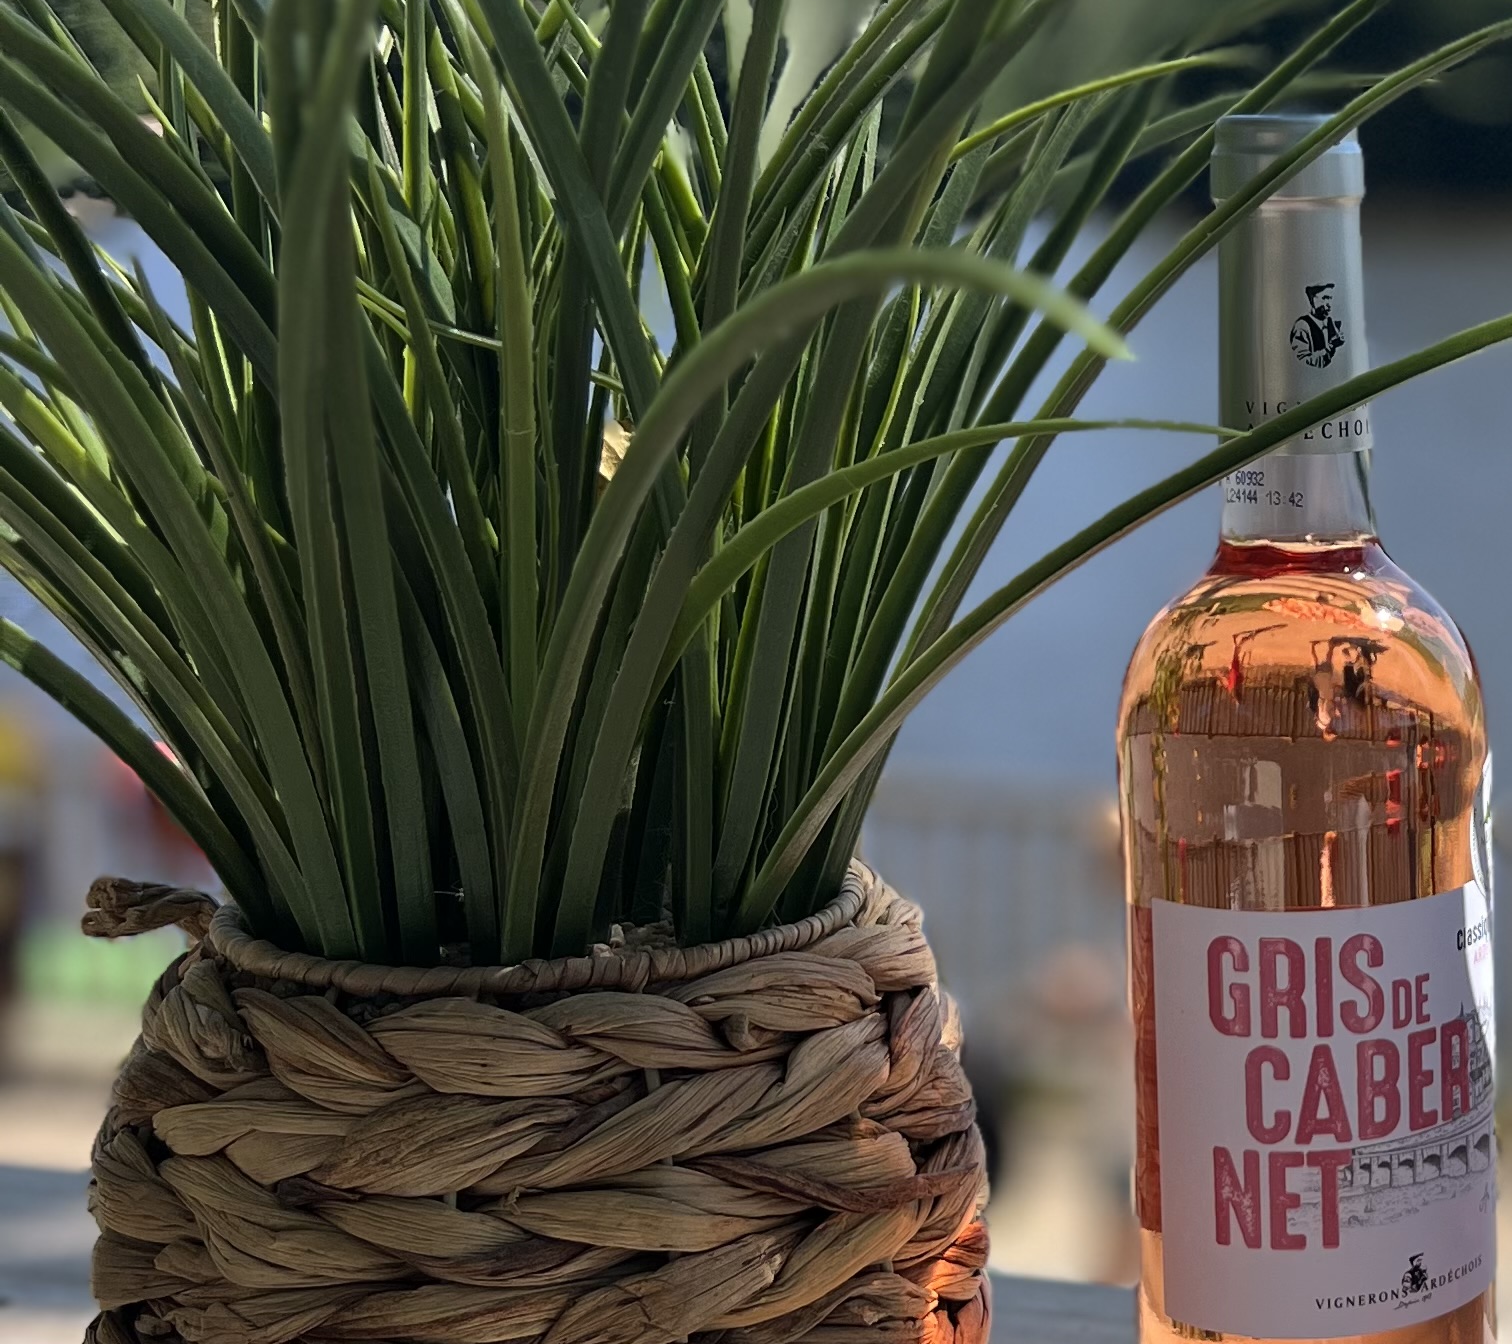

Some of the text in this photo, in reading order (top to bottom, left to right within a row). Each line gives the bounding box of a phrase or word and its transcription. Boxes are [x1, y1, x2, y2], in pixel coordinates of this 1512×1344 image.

[1207, 933, 1431, 1039] GRIS DE
[1245, 1018, 1471, 1145] CABER
[1213, 1145, 1353, 1251] NET
[1315, 1287, 1408, 1310] VIGNERONS
[1421, 1255, 1483, 1293] ARDÉCHOIS
